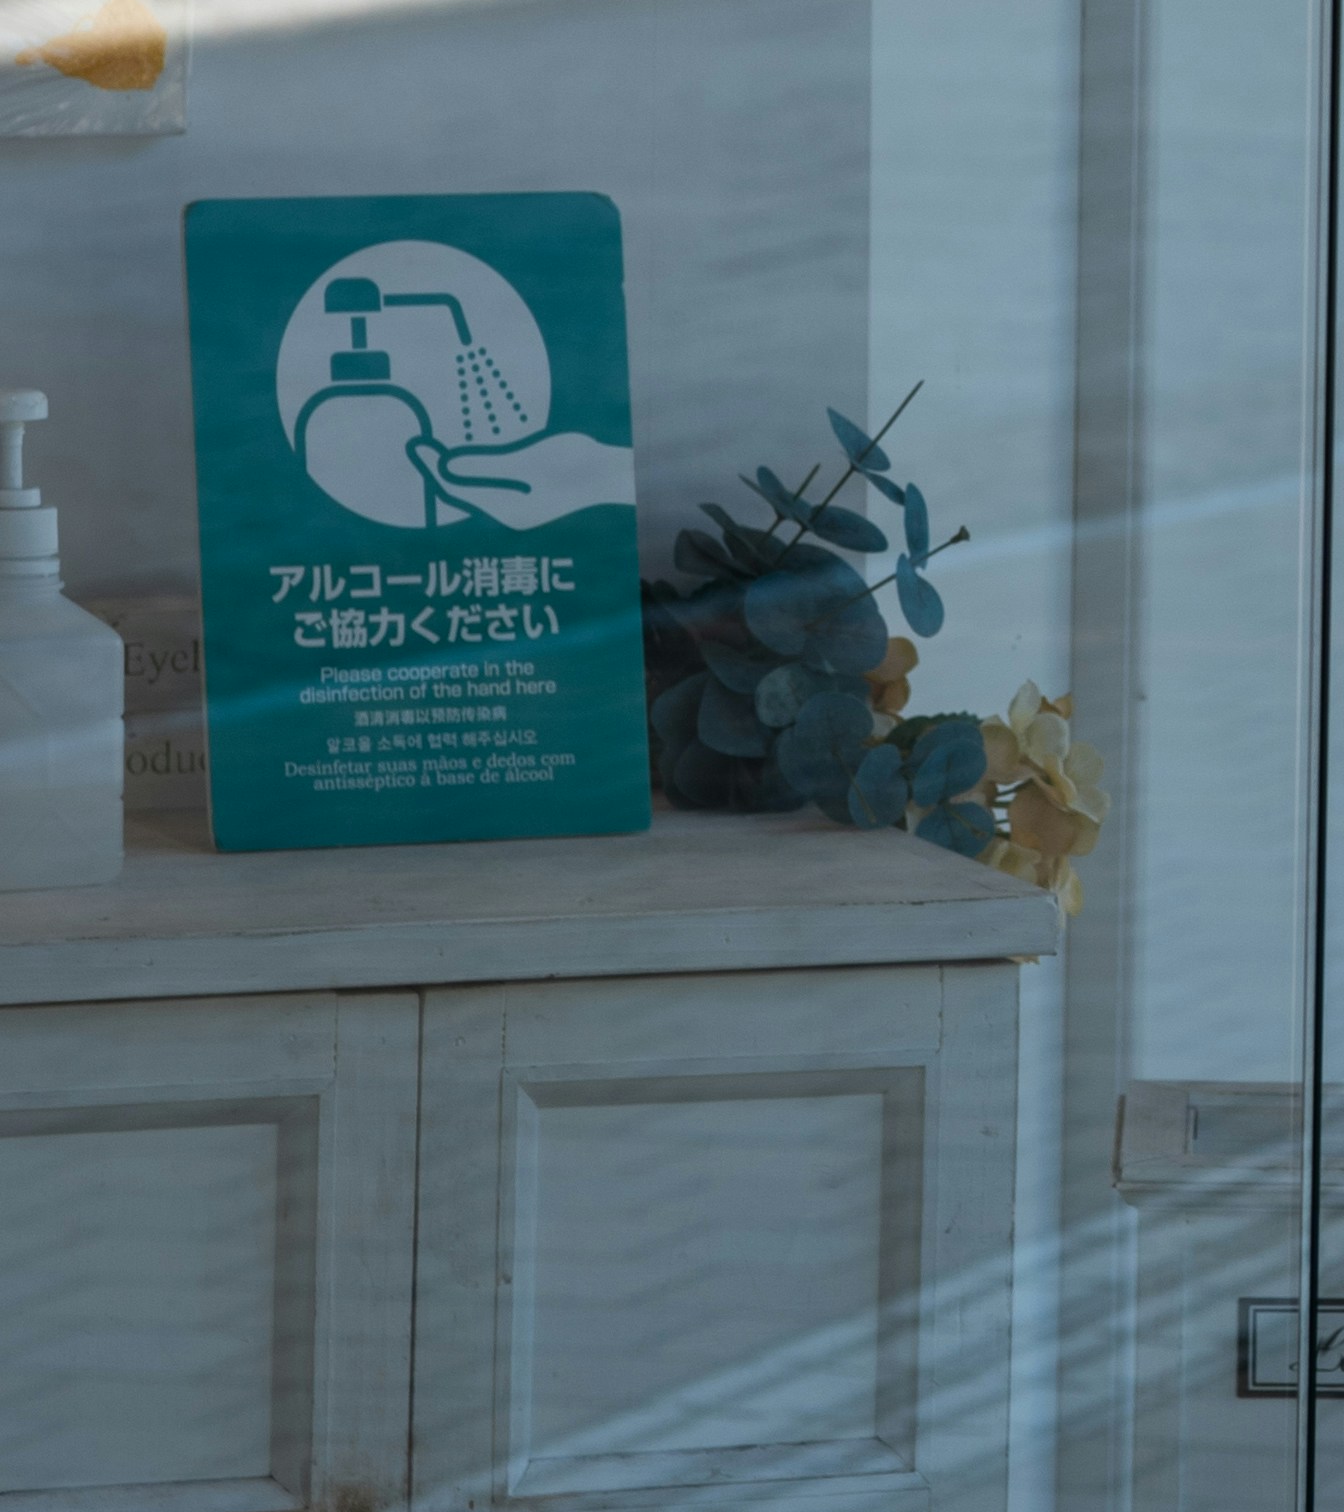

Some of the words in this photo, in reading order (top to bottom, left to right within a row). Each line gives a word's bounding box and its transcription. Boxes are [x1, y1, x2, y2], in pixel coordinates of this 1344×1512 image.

[269, 555, 576, 604] アルコール消毒に
[293, 603, 560, 649] ご協力ください
[320, 666, 383, 684] Please
[387, 662, 479, 683] cooperate
[484, 661, 500, 677] in
[505, 659, 535, 676] the
[300, 684, 405, 705] disinfection
[409, 682, 427, 700] of
[433, 681, 462, 699] the
[467, 679, 511, 697] hand
[516, 678, 557, 695] here
[377, 760, 418, 773] suas
[472, 757, 482, 769] e
[486, 752, 536, 768] dedos
[540, 753, 576, 766] com
[436, 770, 475, 786] base
[479, 768, 501, 784] de
